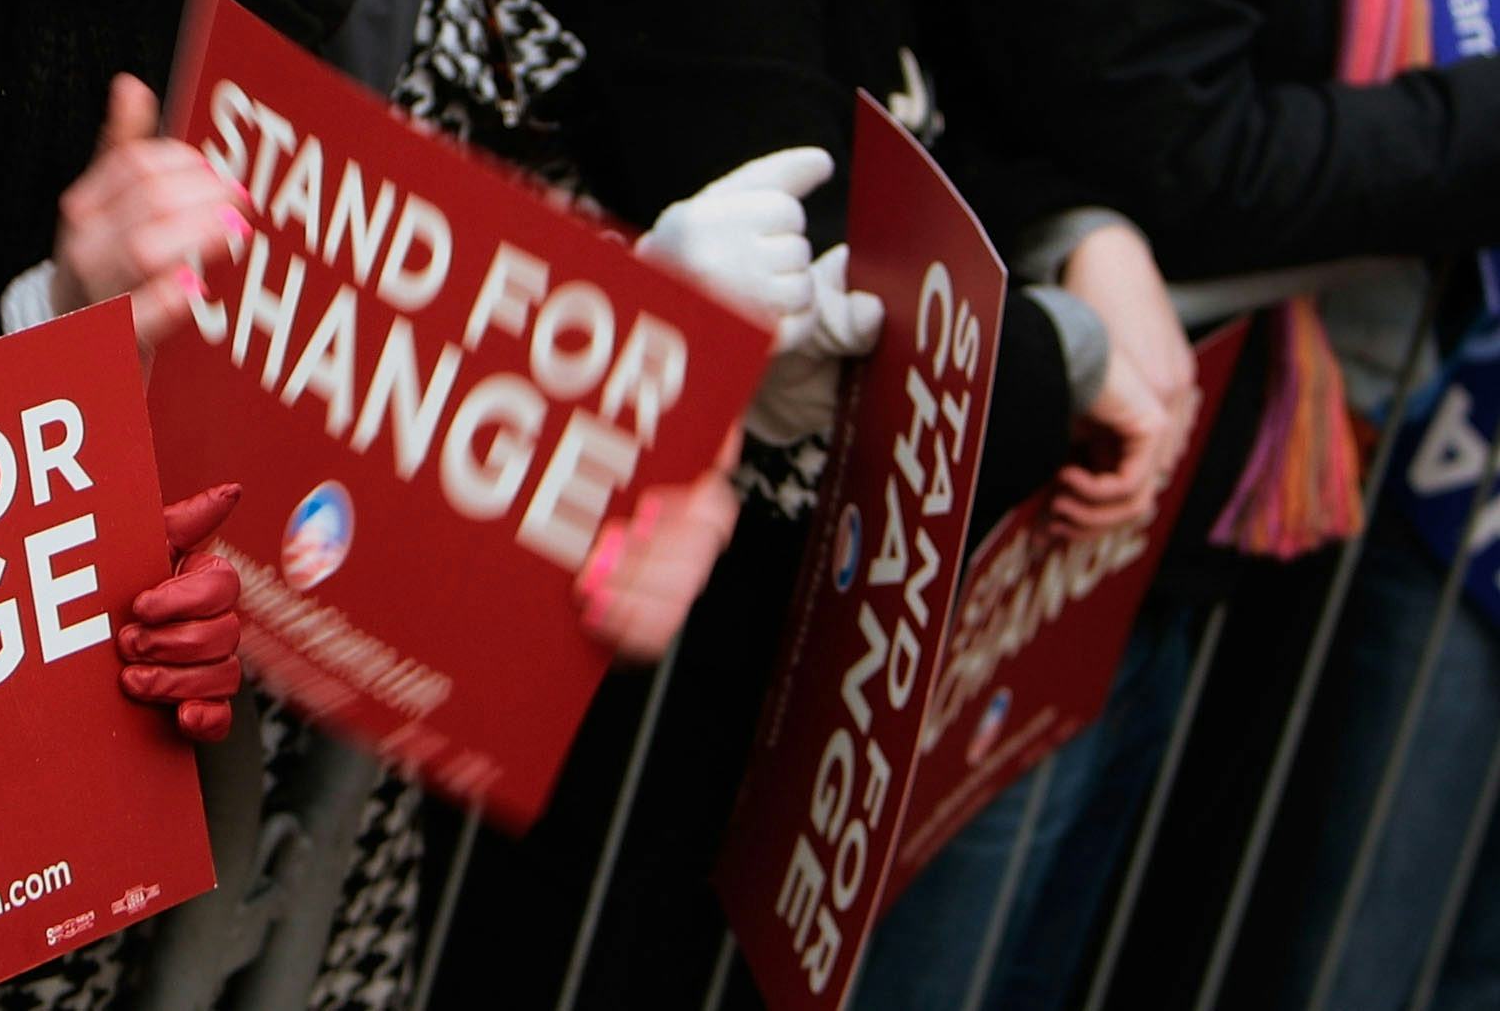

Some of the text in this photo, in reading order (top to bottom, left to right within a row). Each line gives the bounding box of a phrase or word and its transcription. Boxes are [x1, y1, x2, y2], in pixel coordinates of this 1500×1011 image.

[200, 78, 687, 450] STAND FOR
[776, 260, 953, 953] CHANGE
[887, 300, 980, 710] STAND
[801, 738, 891, 995] FOR
